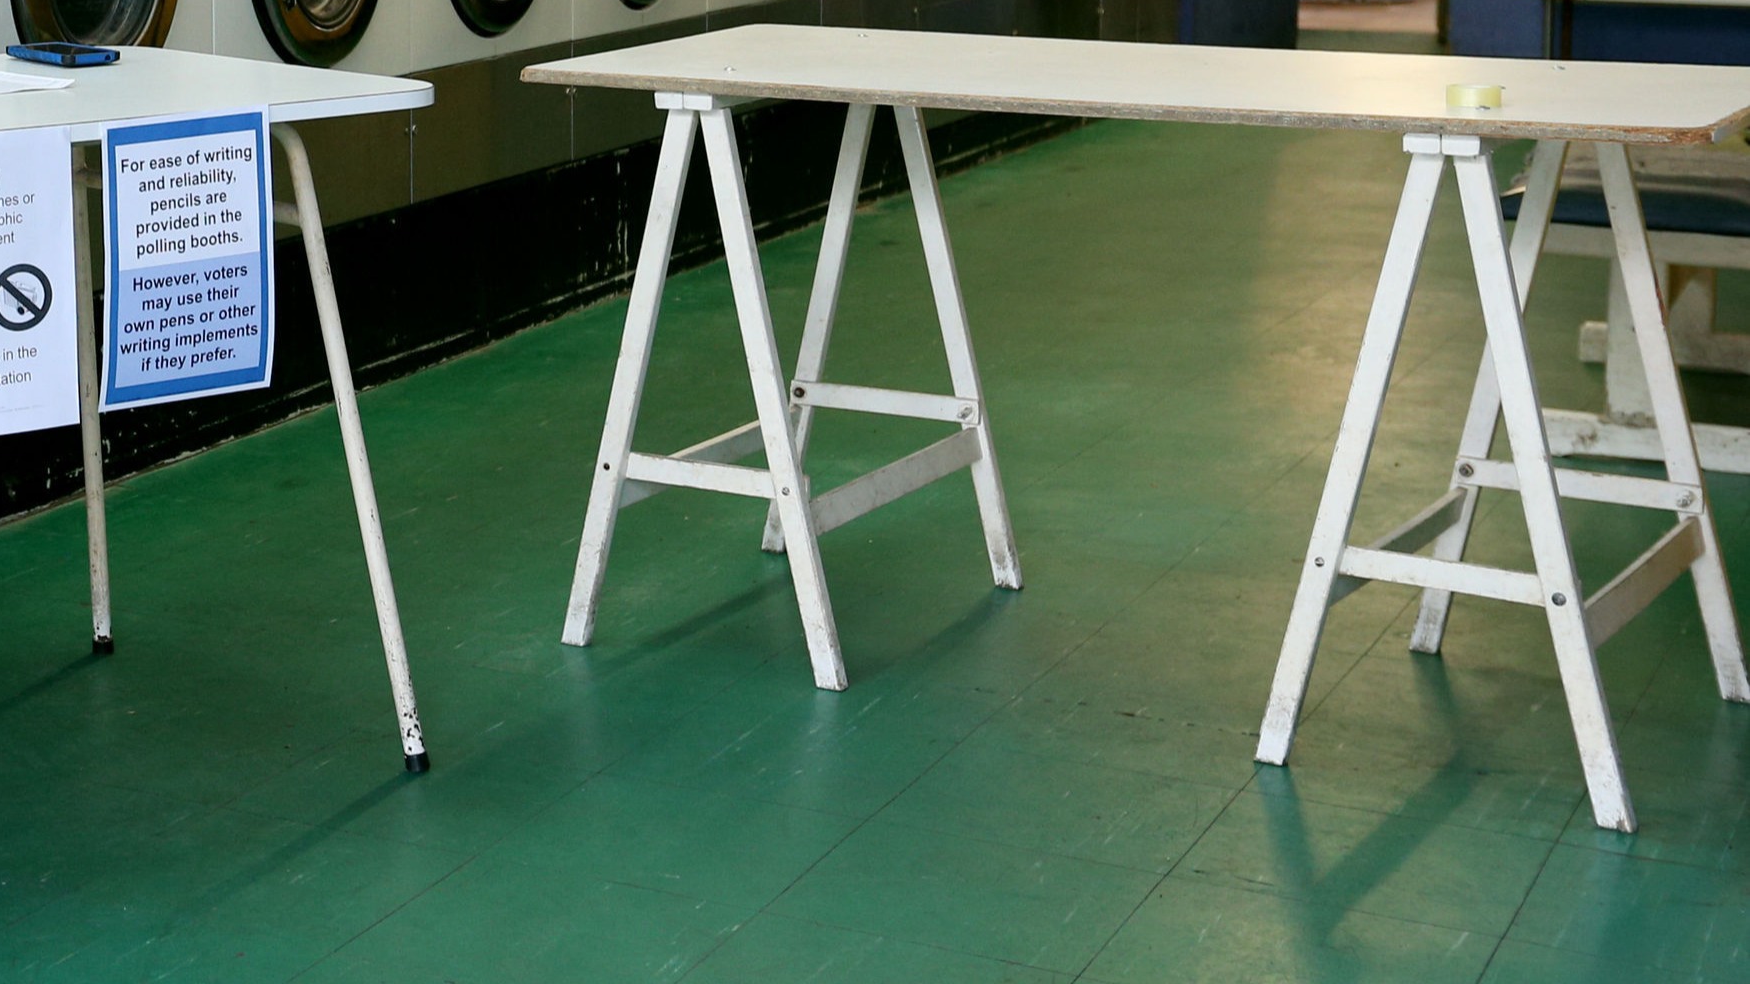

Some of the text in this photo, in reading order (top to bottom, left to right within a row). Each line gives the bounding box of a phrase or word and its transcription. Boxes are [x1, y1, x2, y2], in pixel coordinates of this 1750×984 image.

[121, 146, 252, 174] For ease of writing
[138, 169, 237, 192] and reliability,
[23, 193, 35, 205] or
[150, 191, 227, 215] pencils are
[136, 209, 242, 237] provided in the
[137, 230, 243, 259] polling booths.
[133, 265, 248, 292] However, voters
[142, 285, 240, 312] may use their
[124, 304, 256, 334] own pens or other
[120, 323, 258, 355] writing implements
[2, 348, 14, 362] in
[17, 345, 38, 360] the
[141, 347, 237, 372] if they prefer.
